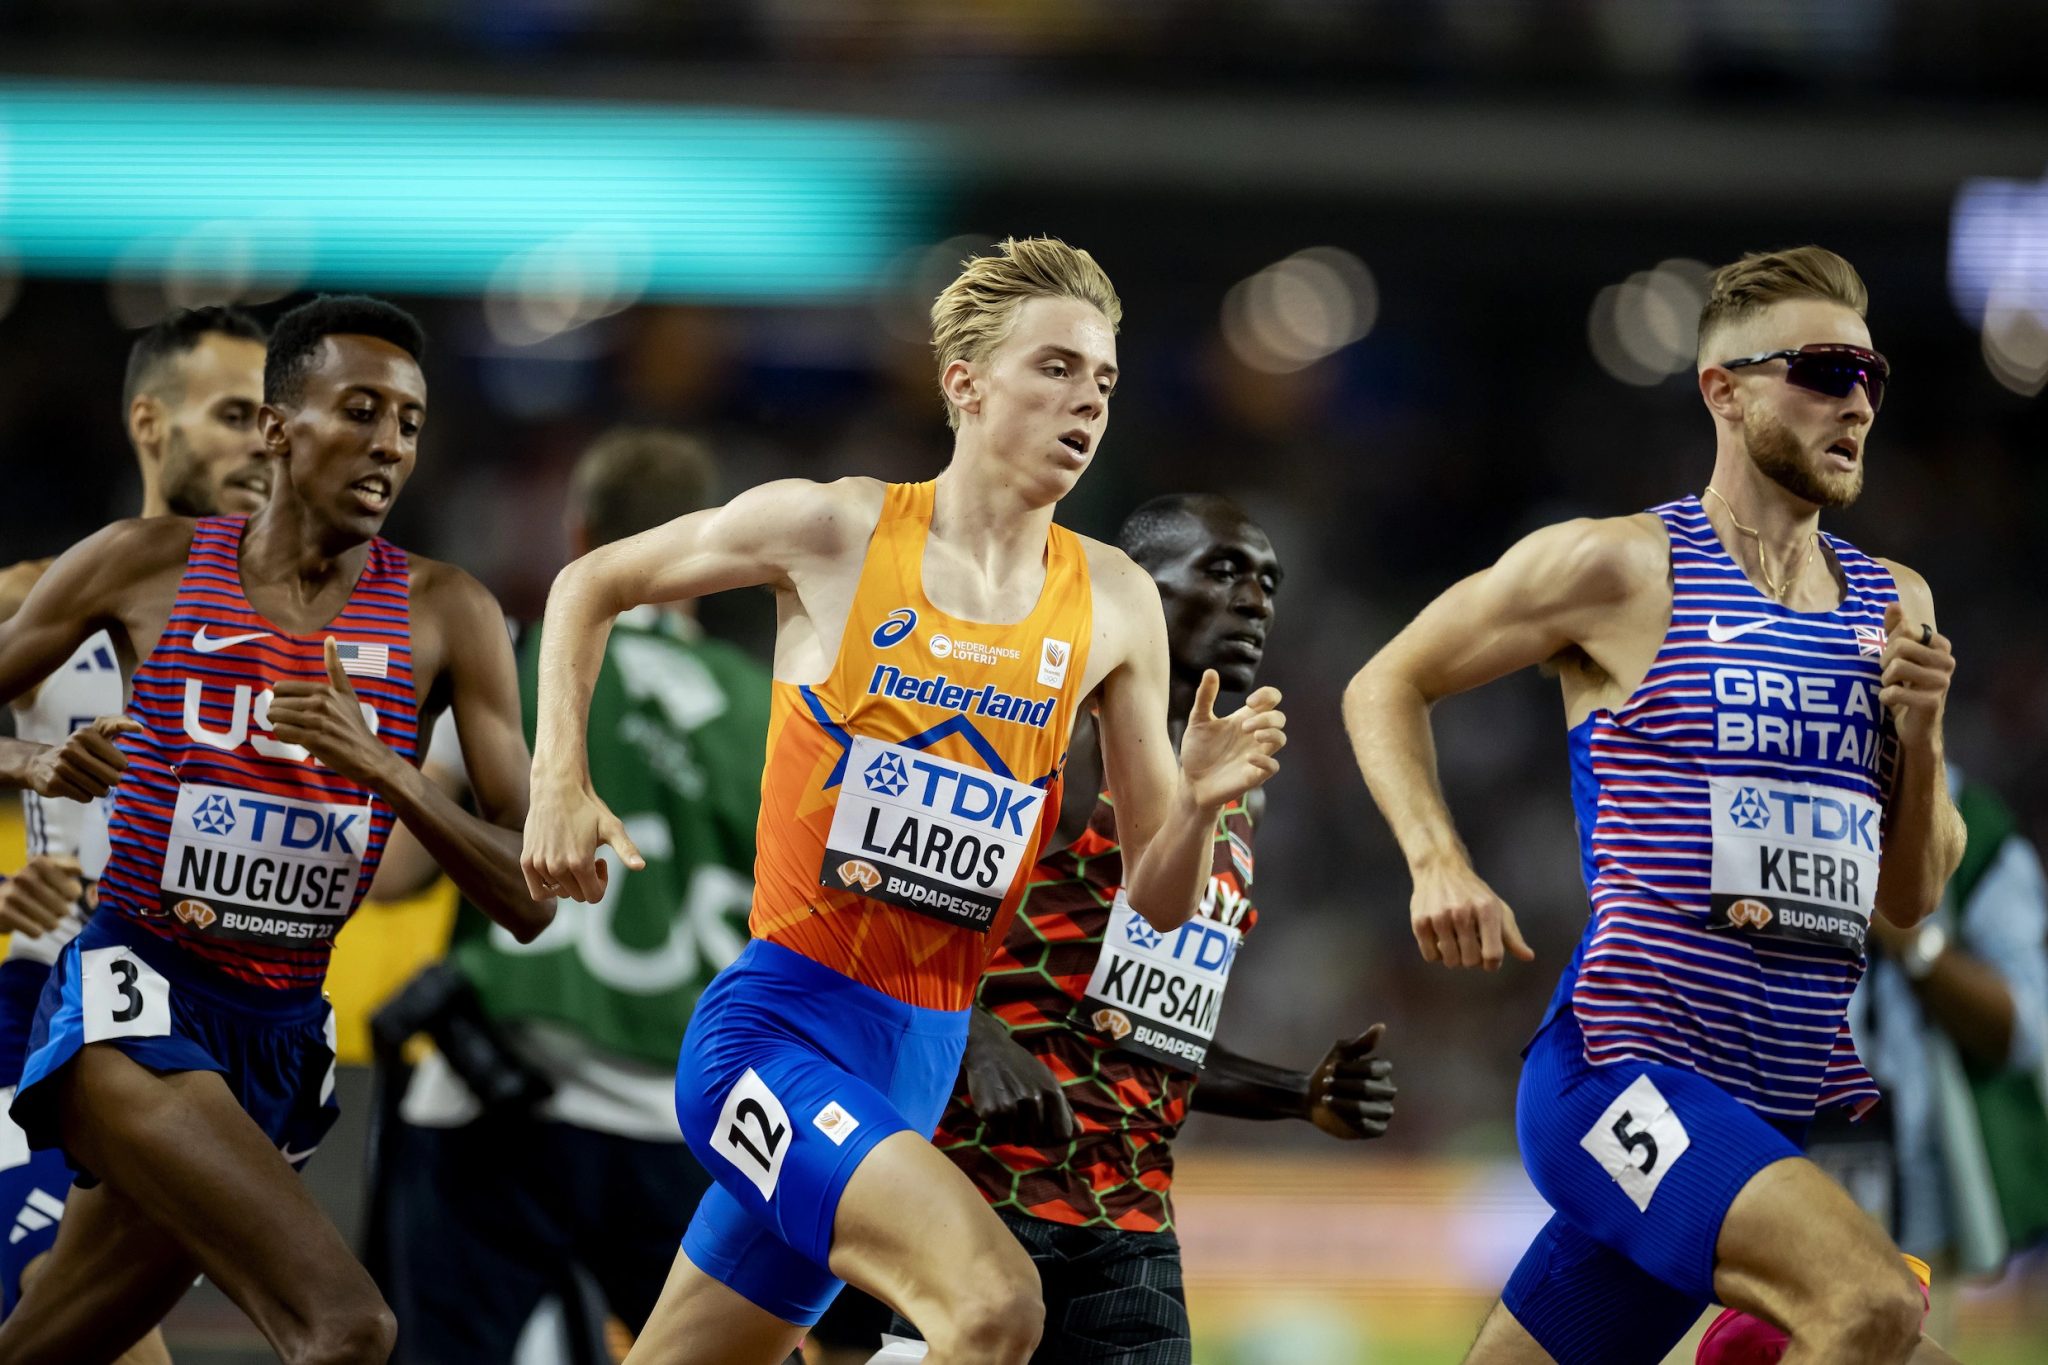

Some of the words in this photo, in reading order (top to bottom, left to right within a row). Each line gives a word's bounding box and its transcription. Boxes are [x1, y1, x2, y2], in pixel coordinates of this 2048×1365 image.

[953, 648, 997, 665] LOTERIJ
[954, 640, 1021, 660] NEDERLANDSE
[239, 798, 359, 854] TDK
[913, 759, 1037, 837] TDK
[1769, 790, 1875, 852] TDK
[177, 845, 350, 910] NUGUSE
[861, 806, 1005, 889] LAROS
[1760, 845, 1859, 906] KERR
[110, 959, 144, 1023] 3
[1100, 954, 1220, 1034] KIPSAN
[728, 1098, 786, 1173] 12
[1611, 1109, 1658, 1176] 5
